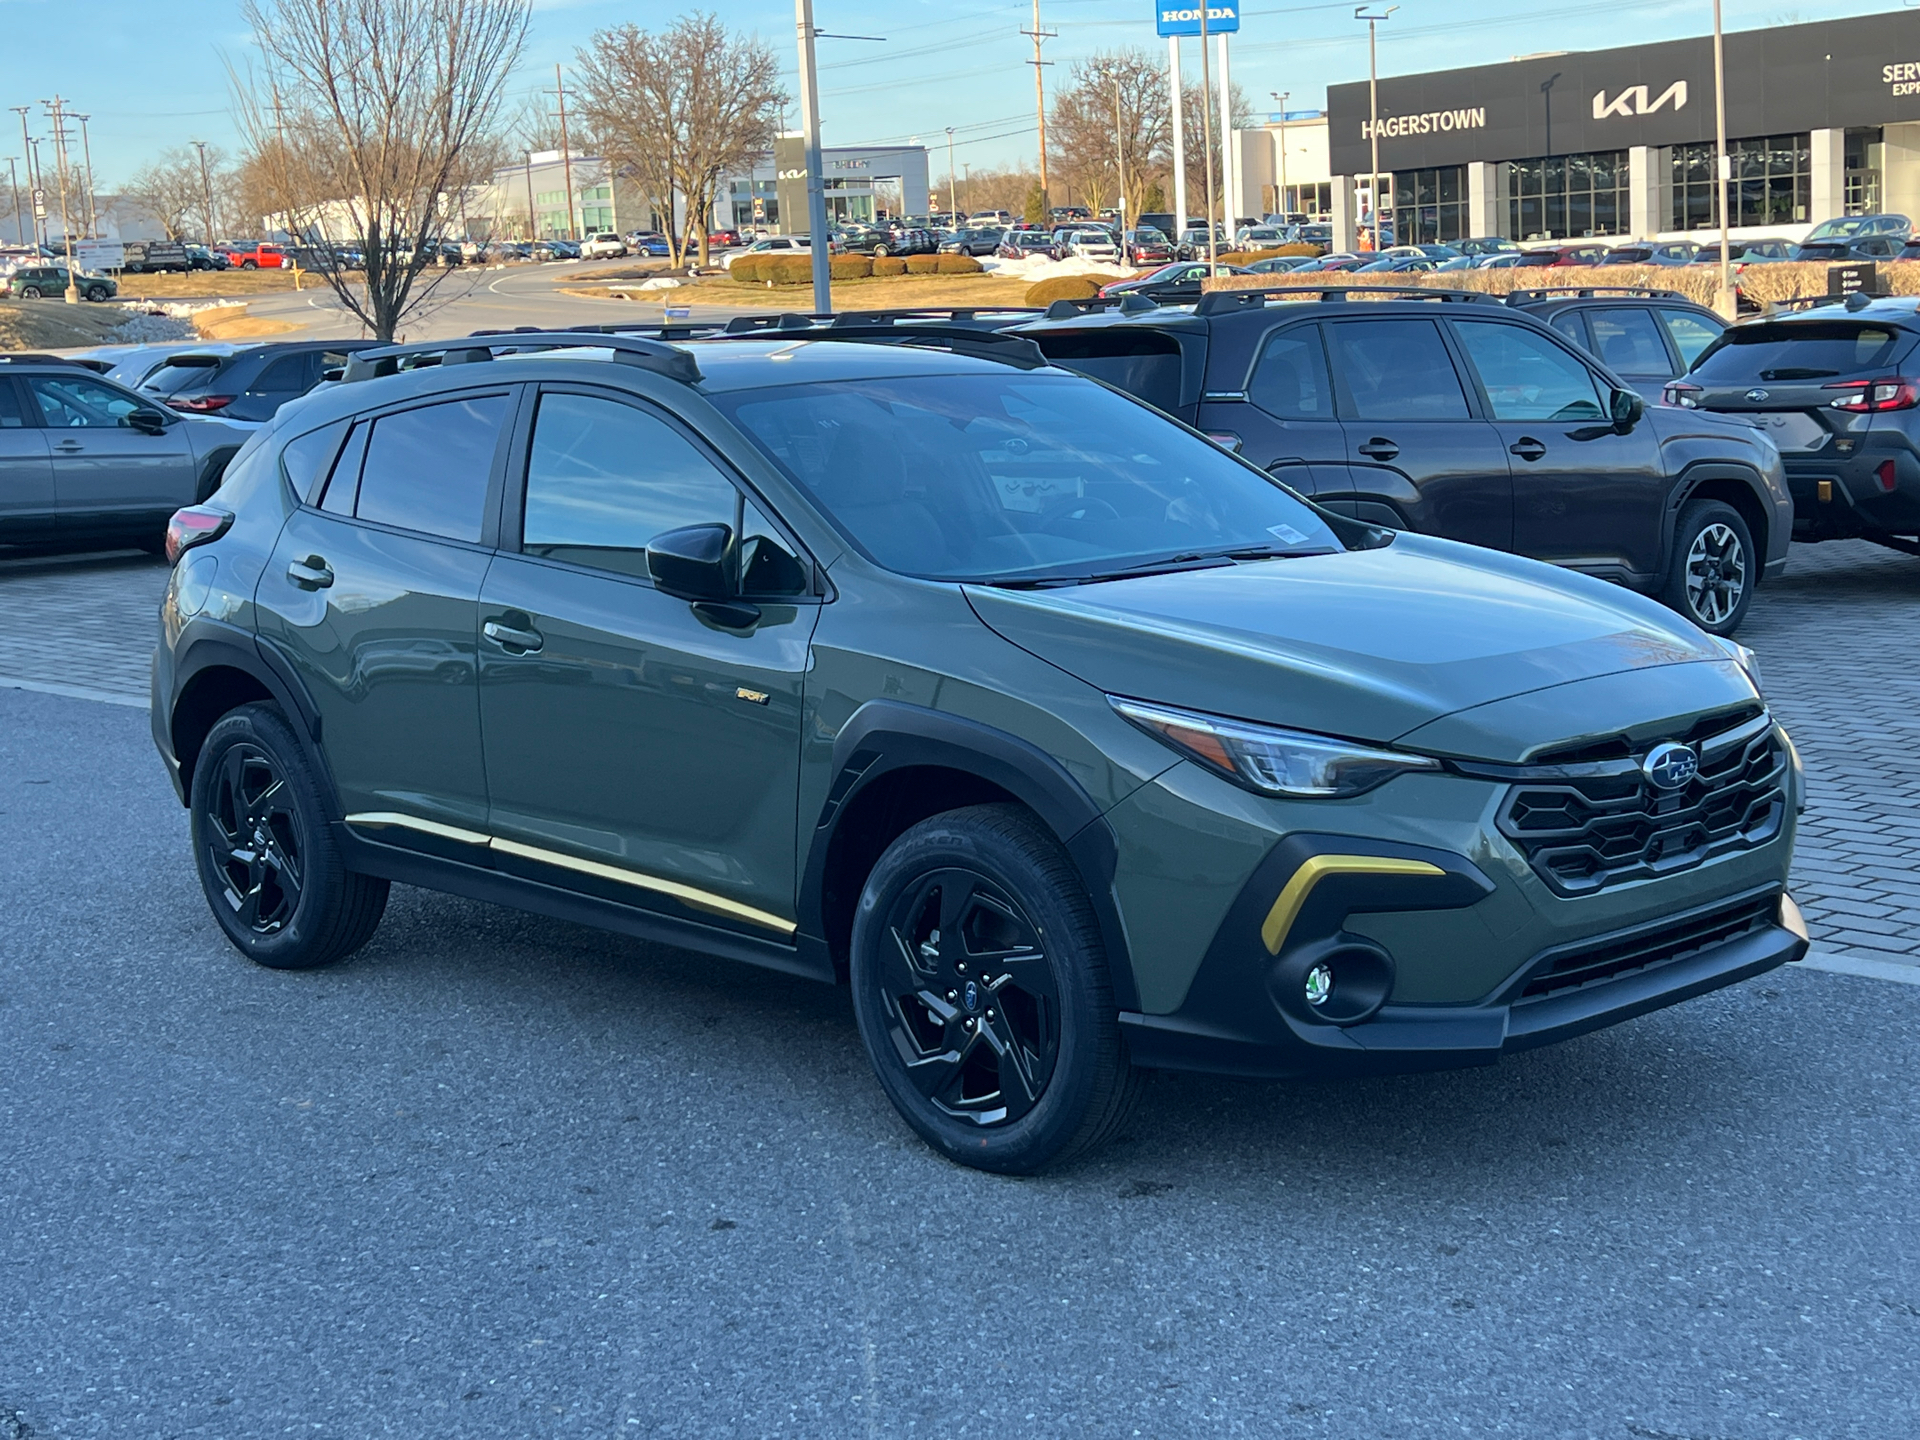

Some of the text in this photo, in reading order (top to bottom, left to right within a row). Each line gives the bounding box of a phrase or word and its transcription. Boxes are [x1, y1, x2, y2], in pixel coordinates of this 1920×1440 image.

[1162, 8, 1236, 22] HONDA
[1593, 80, 1687, 119] KIA
[1361, 107, 1485, 139] HAGERSTOWN
